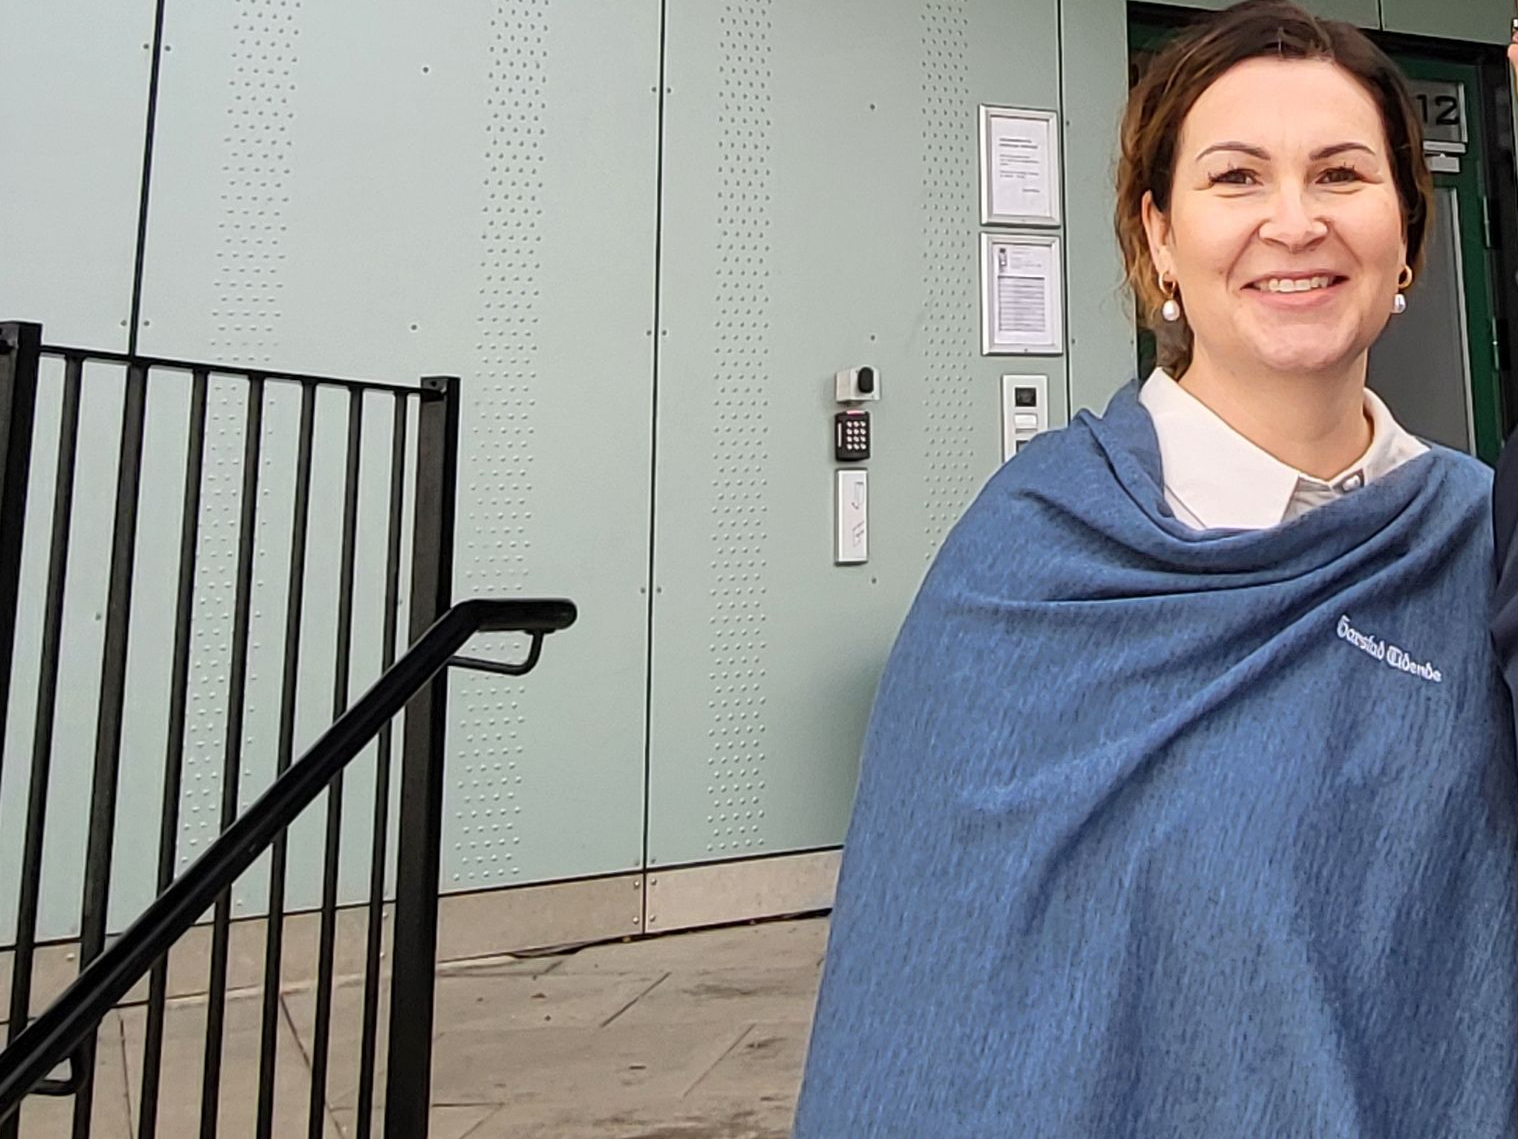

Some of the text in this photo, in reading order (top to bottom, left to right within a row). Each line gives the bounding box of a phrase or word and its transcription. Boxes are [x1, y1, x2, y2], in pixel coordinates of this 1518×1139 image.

[1416, 94, 1460, 125] 12
[1336, 614, 1442, 683] Harstad Tidende
